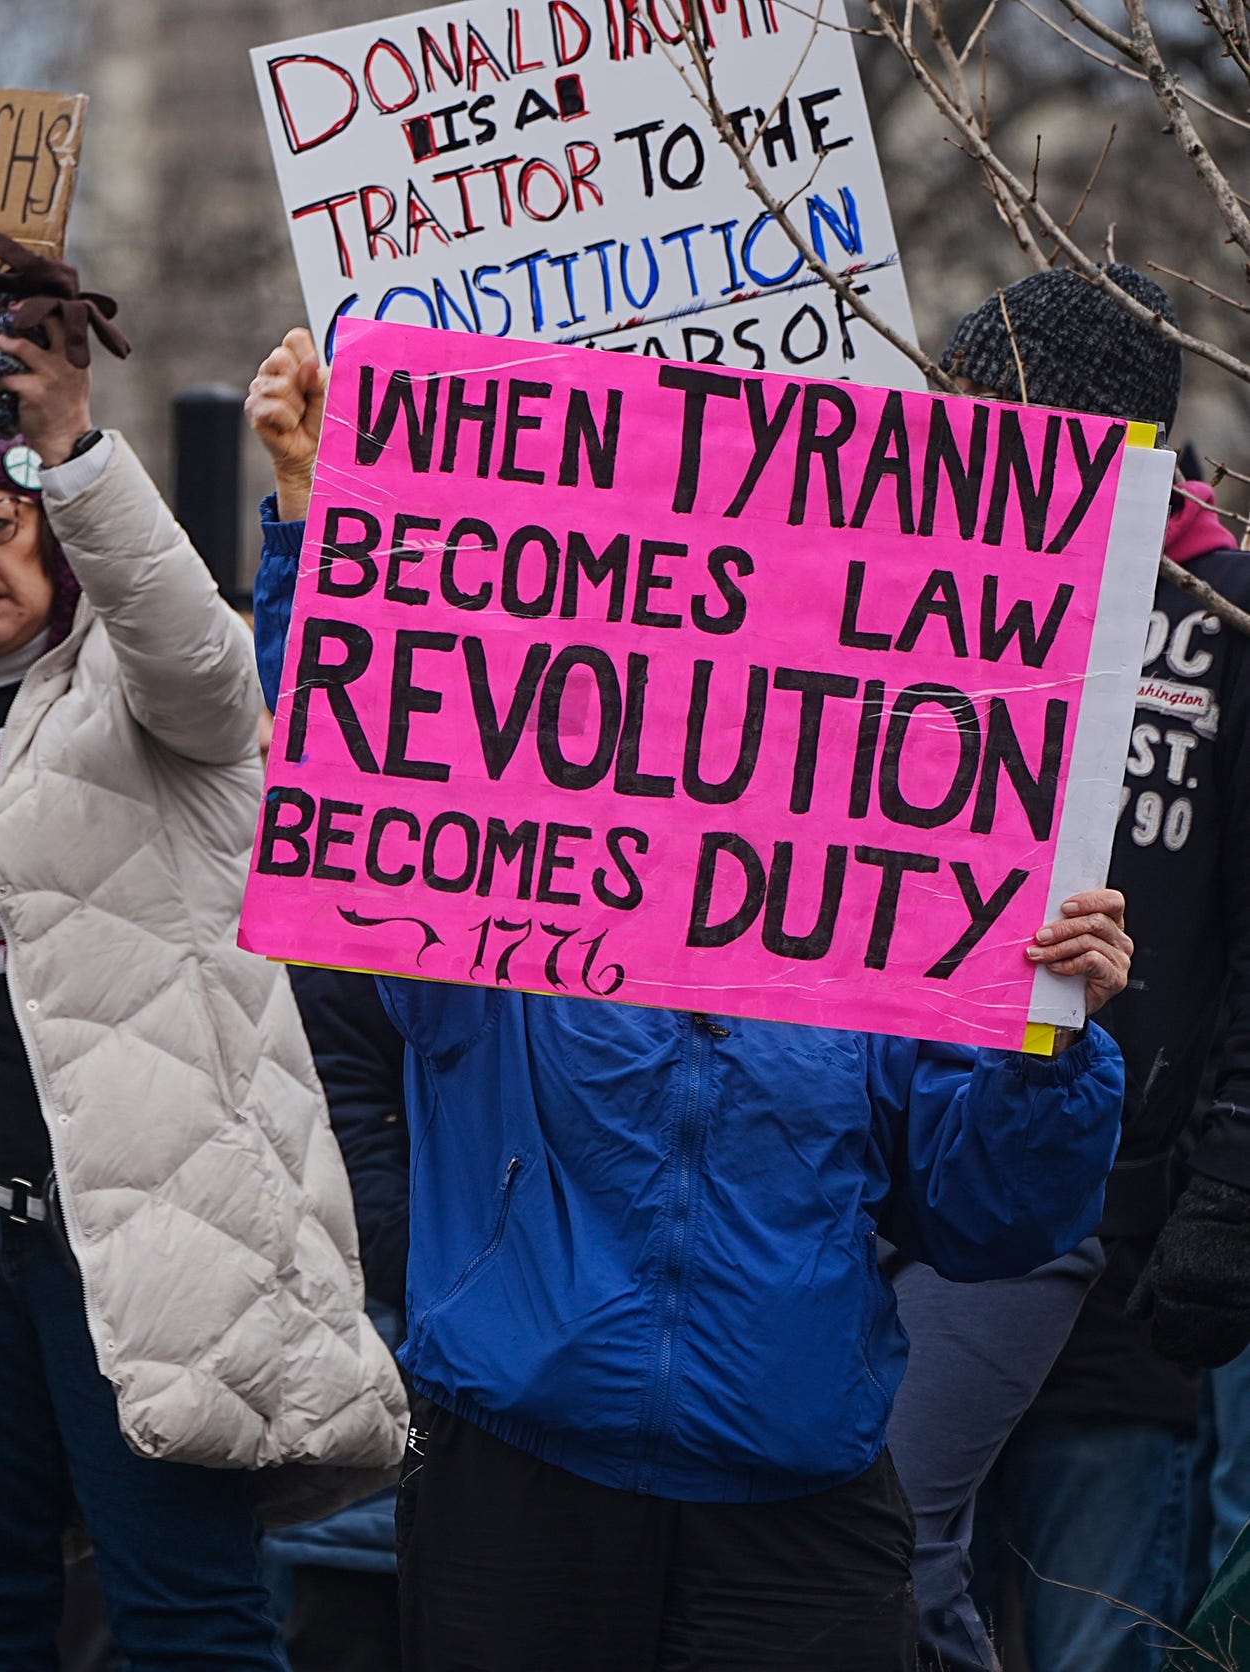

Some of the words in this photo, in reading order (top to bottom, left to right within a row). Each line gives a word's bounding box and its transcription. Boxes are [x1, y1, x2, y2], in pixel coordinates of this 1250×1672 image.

[268, 4, 592, 155] DONALD
[430, 94, 497, 155] IS
[514, 88, 560, 131] A
[291, 141, 604, 279] TRAITOR
[614, 120, 705, 198] TO
[713, 87, 855, 168] THE
[325, 186, 864, 367] CONSTITUTION
[781, 284, 870, 364] OF
[353, 365, 623, 489] WHEN
[659, 363, 1128, 554] TYRANNY
[316, 506, 755, 634] BECOMES
[837, 560, 1075, 671] LAW
[283, 617, 1069, 843] REVOLUTION
[254, 786, 650, 912] BECOMES
[685, 831, 1030, 981] DUTY
[467, 914, 626, 996] 1776
